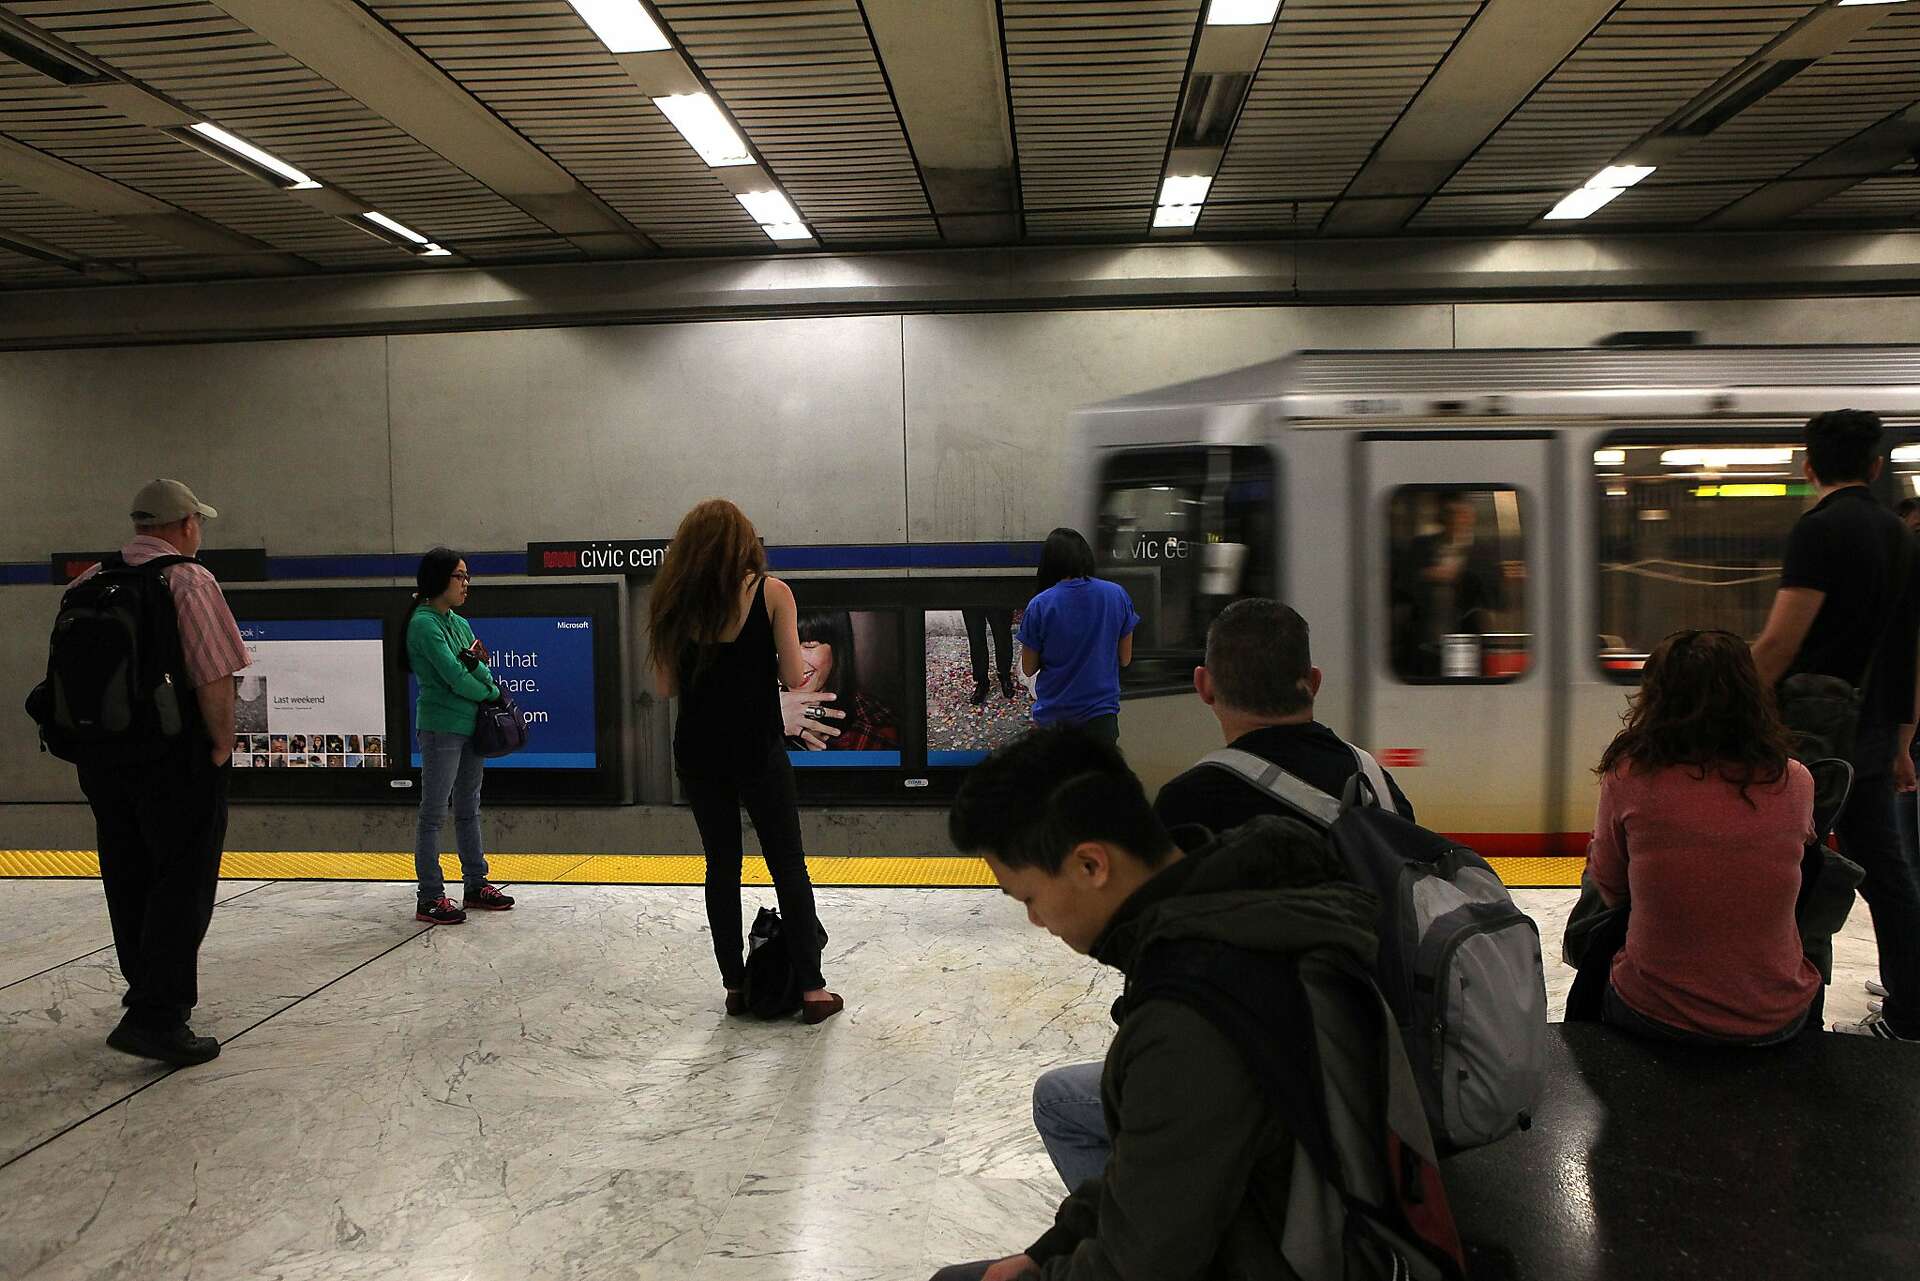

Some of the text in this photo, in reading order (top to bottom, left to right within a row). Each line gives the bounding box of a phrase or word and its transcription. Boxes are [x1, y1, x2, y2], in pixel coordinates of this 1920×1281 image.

[580, 543, 624, 567] civic
[557, 621, 589, 629] Microsoft
[504, 650, 538, 668] that
[495, 674, 540, 692] hare.
[273, 695, 325, 704] Last weekend
